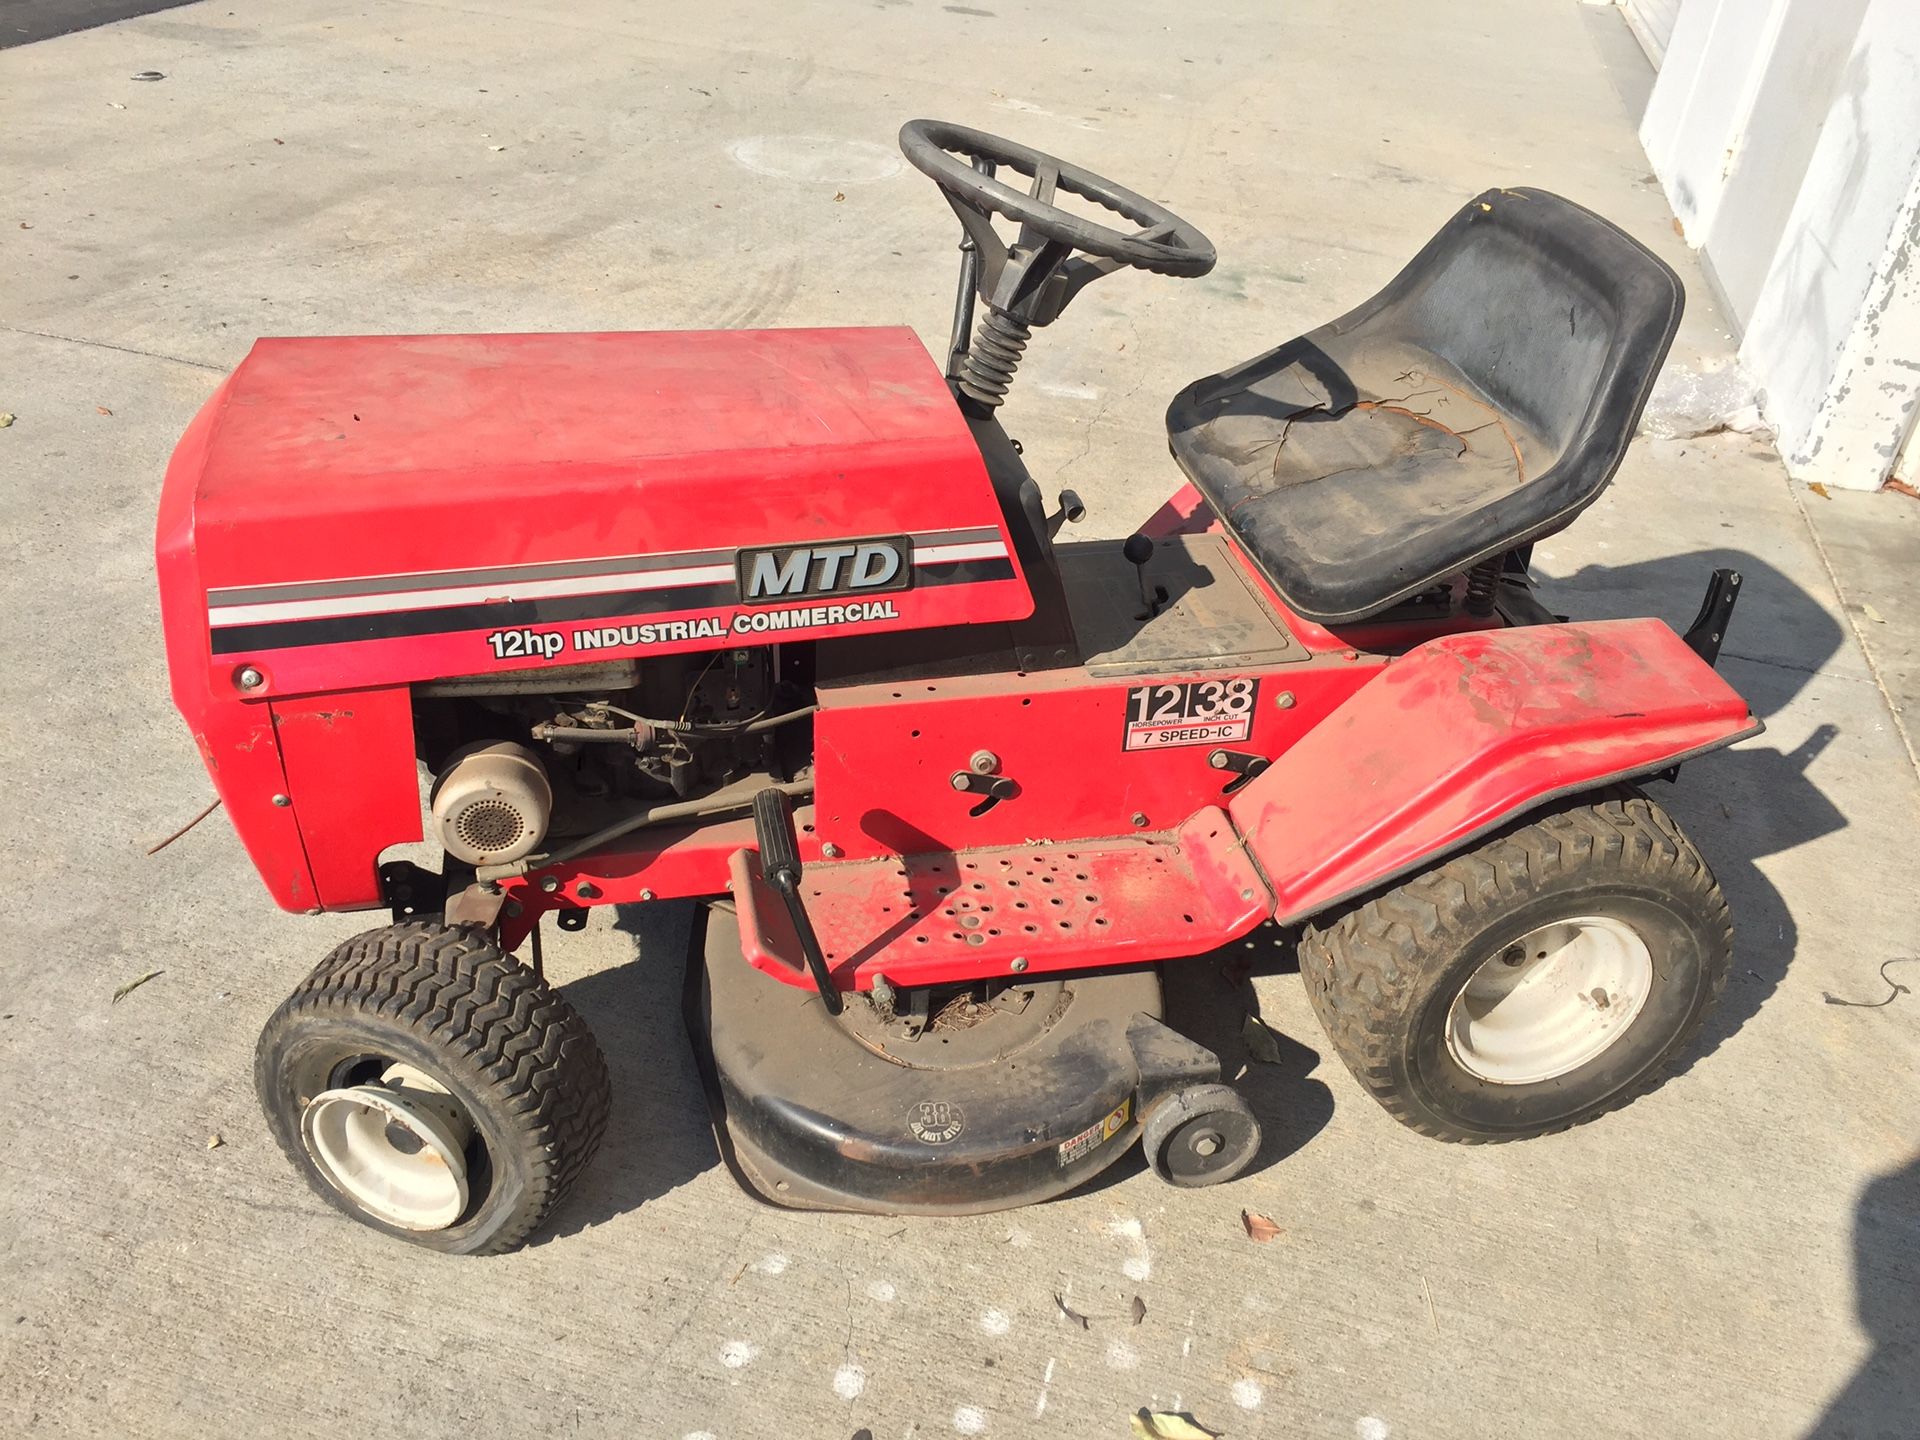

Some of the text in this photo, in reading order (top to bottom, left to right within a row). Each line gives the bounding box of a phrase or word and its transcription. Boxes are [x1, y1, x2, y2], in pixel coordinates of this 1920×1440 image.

[749, 543, 899, 597] MTD
[489, 630, 564, 658] 12hp
[1131, 679, 1254, 722] 12 38
[1131, 718, 1183, 728] HORSEPOWER
[1203, 714, 1221, 722] INCH
[1143, 725, 1233, 744] 7 SPEED-IC
[920, 1101, 951, 1127] 38
[910, 1120, 961, 1141] DO NOT STEP
[1064, 1124, 1101, 1149] DANGER
